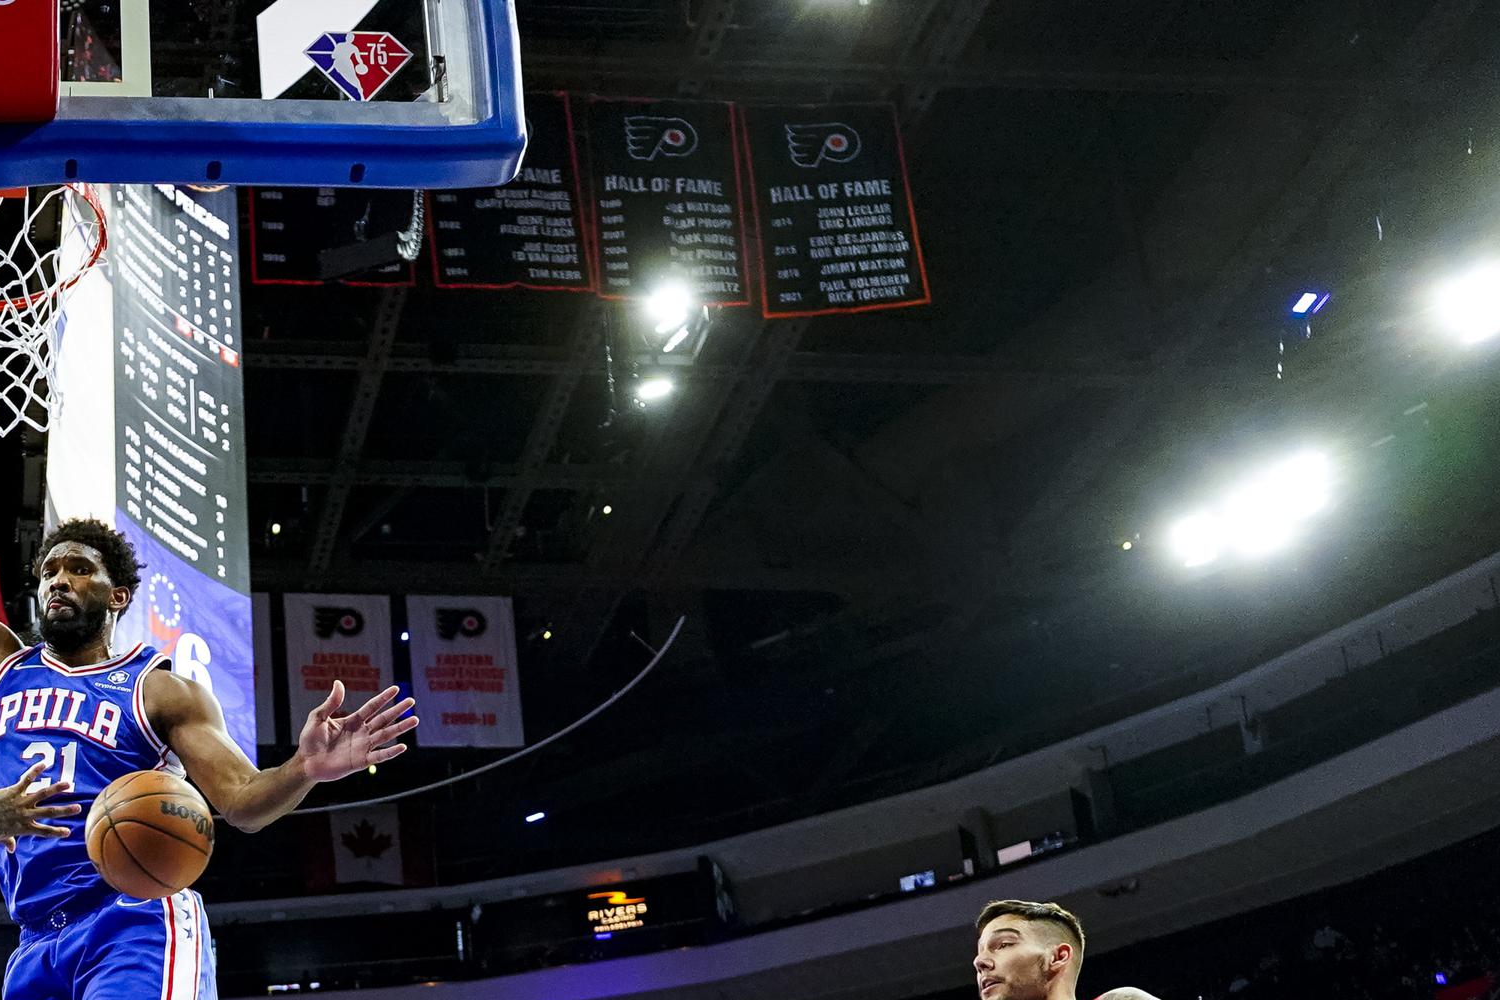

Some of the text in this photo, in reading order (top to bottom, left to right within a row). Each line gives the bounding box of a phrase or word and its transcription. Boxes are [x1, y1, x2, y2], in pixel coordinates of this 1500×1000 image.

[366, 42, 389, 65] 75
[604, 174, 723, 197] HALL OF FAME
[770, 179, 893, 204] HALL OF FAME
[818, 218, 844, 230] ERIC
[809, 236, 835, 247] ERIC
[858, 258, 906, 271] WATSON
[819, 279, 847, 292] PAUL
[94, 682, 132, 694] crypto.com
[20, 741, 78, 796] 21
[588, 903, 648, 922] RIVERS
